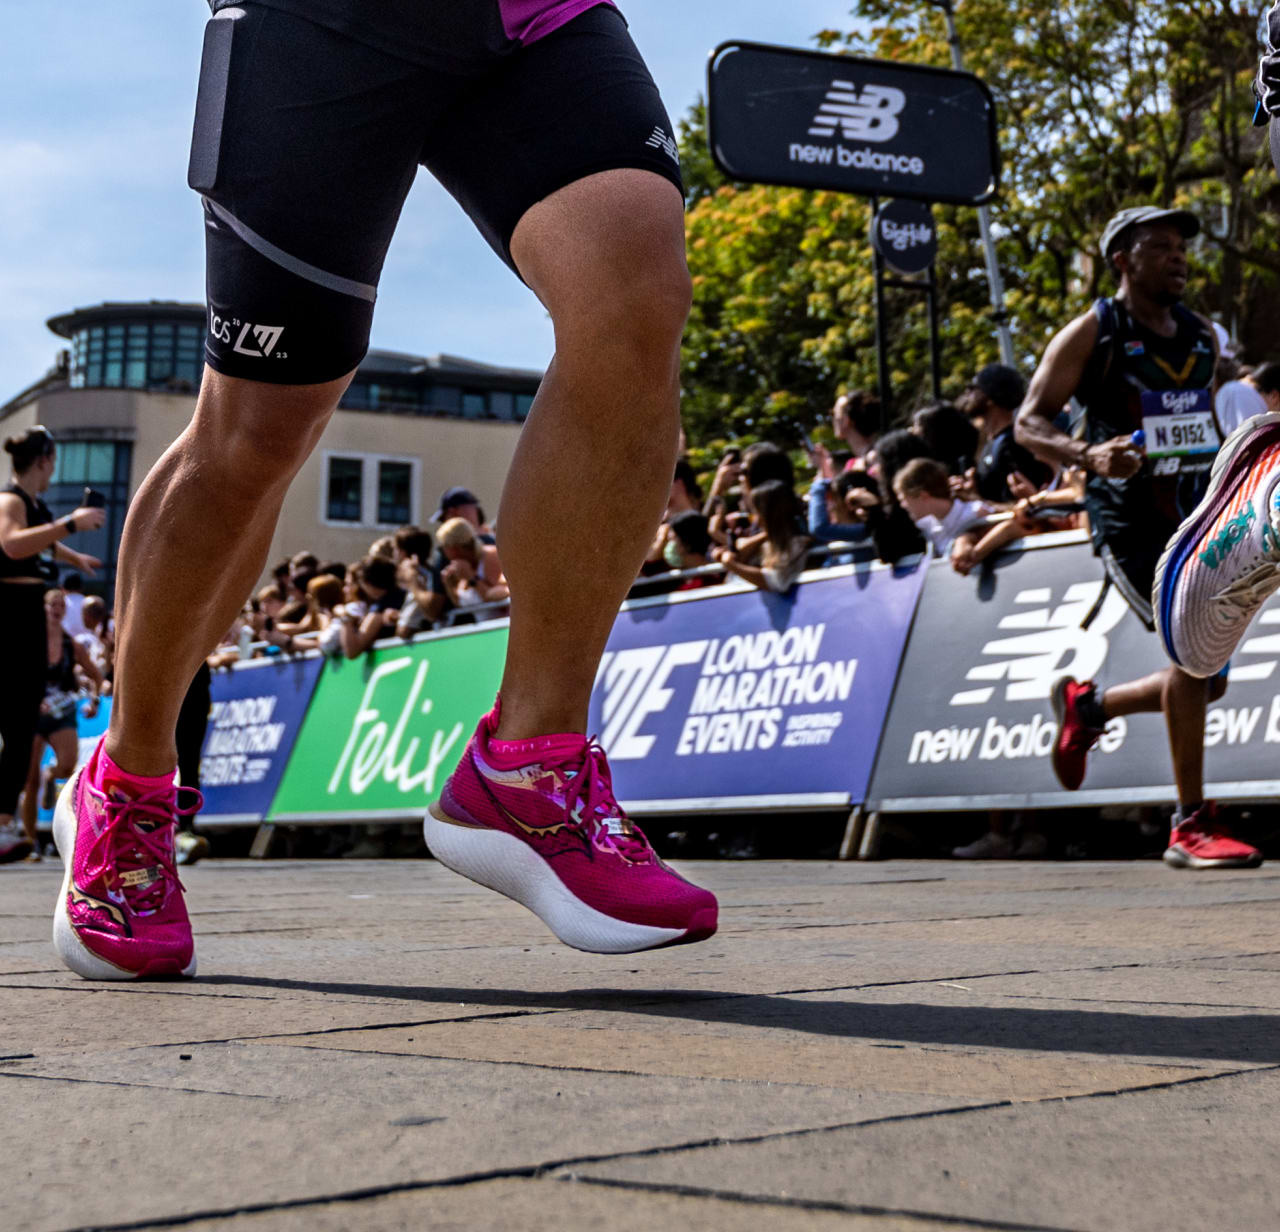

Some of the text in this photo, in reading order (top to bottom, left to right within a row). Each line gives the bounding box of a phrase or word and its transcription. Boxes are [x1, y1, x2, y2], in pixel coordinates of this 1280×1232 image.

[789, 142, 925, 176] new balance
[1155, 424, 1207, 448] N 9152
[701, 623, 826, 676] LONDON
[688, 658, 859, 715] MARATHON
[214, 695, 278, 729] LONDON
[327, 656, 465, 795] Felix
[675, 707, 784, 757] EVENTS
[1204, 706, 1264, 748] ew
[907, 713, 1128, 765] new balae
